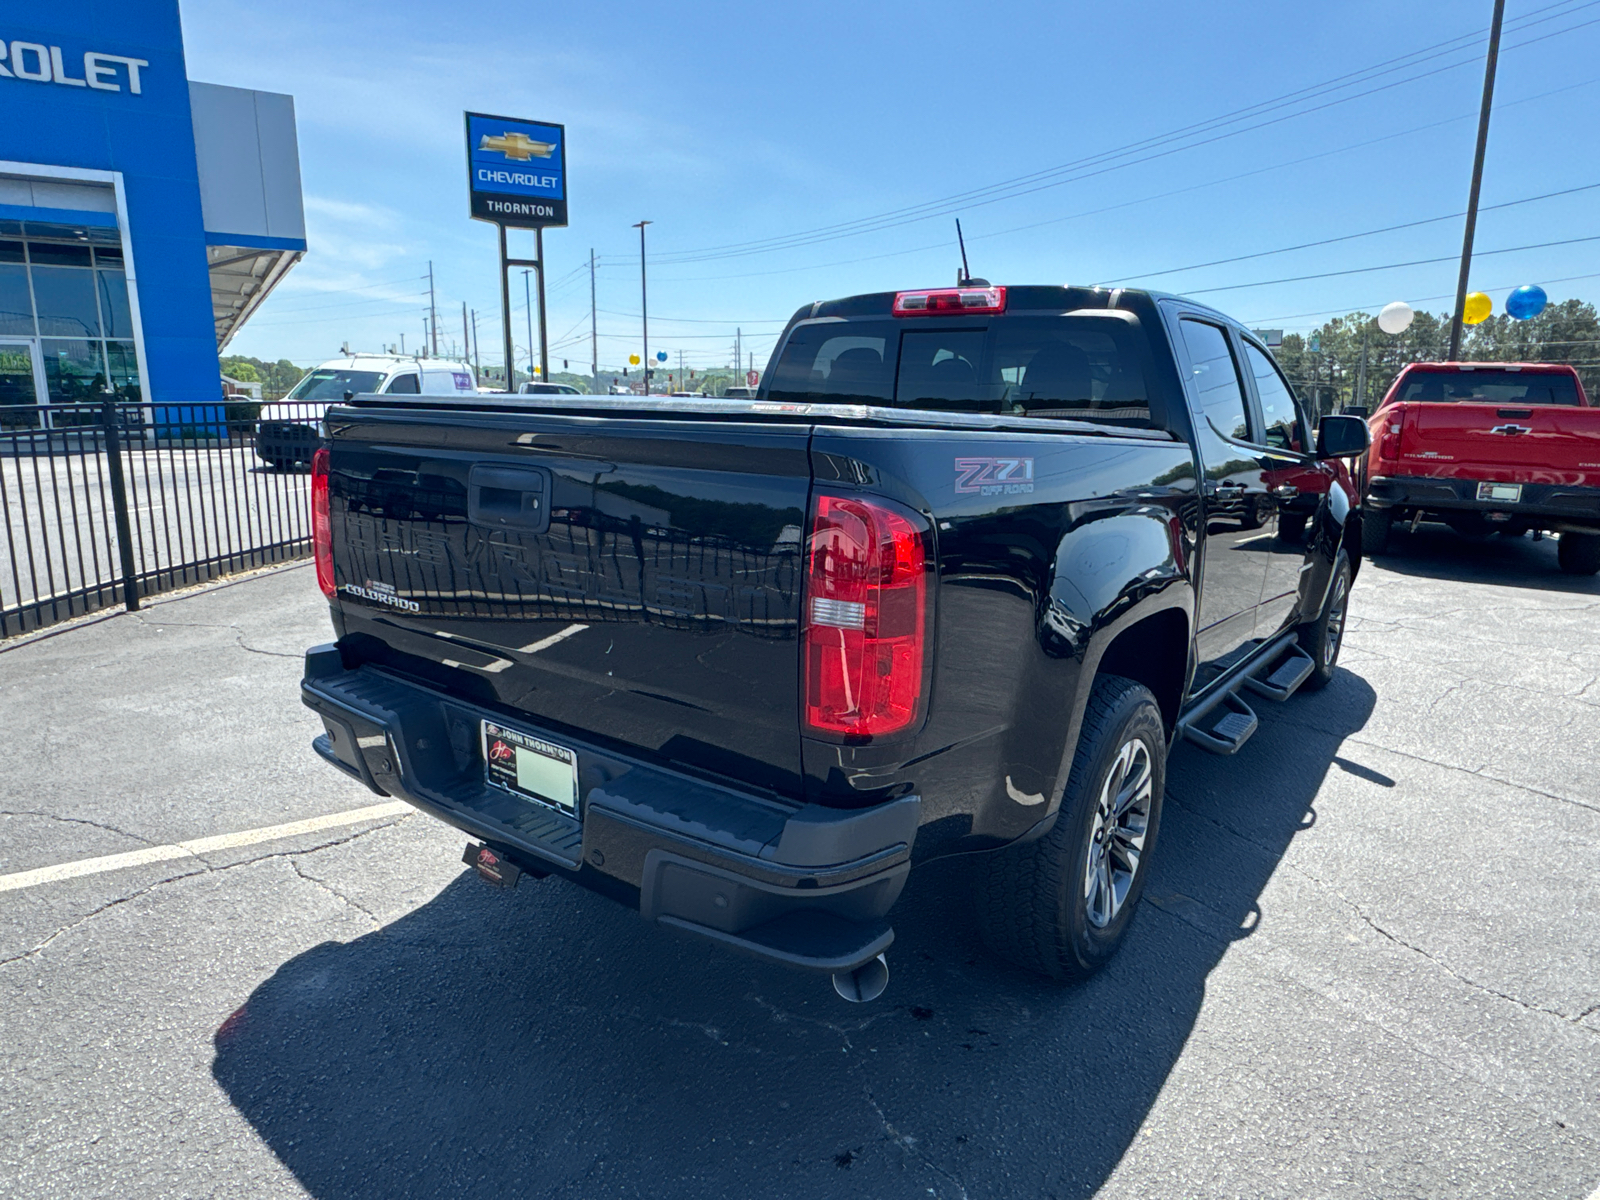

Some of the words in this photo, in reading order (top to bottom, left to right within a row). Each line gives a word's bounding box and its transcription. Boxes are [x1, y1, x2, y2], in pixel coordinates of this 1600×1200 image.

[478, 169, 558, 189] CHEVROLET
[487, 200, 554, 217] THORNTON
[955, 457, 1034, 494] Z71
[981, 486, 1003, 496] OFF
[1004, 483, 1034, 495] ROAD
[345, 583, 420, 612] COLORADO
[502, 729, 524, 744] JOHN
[524, 737, 571, 760] THORNTON
